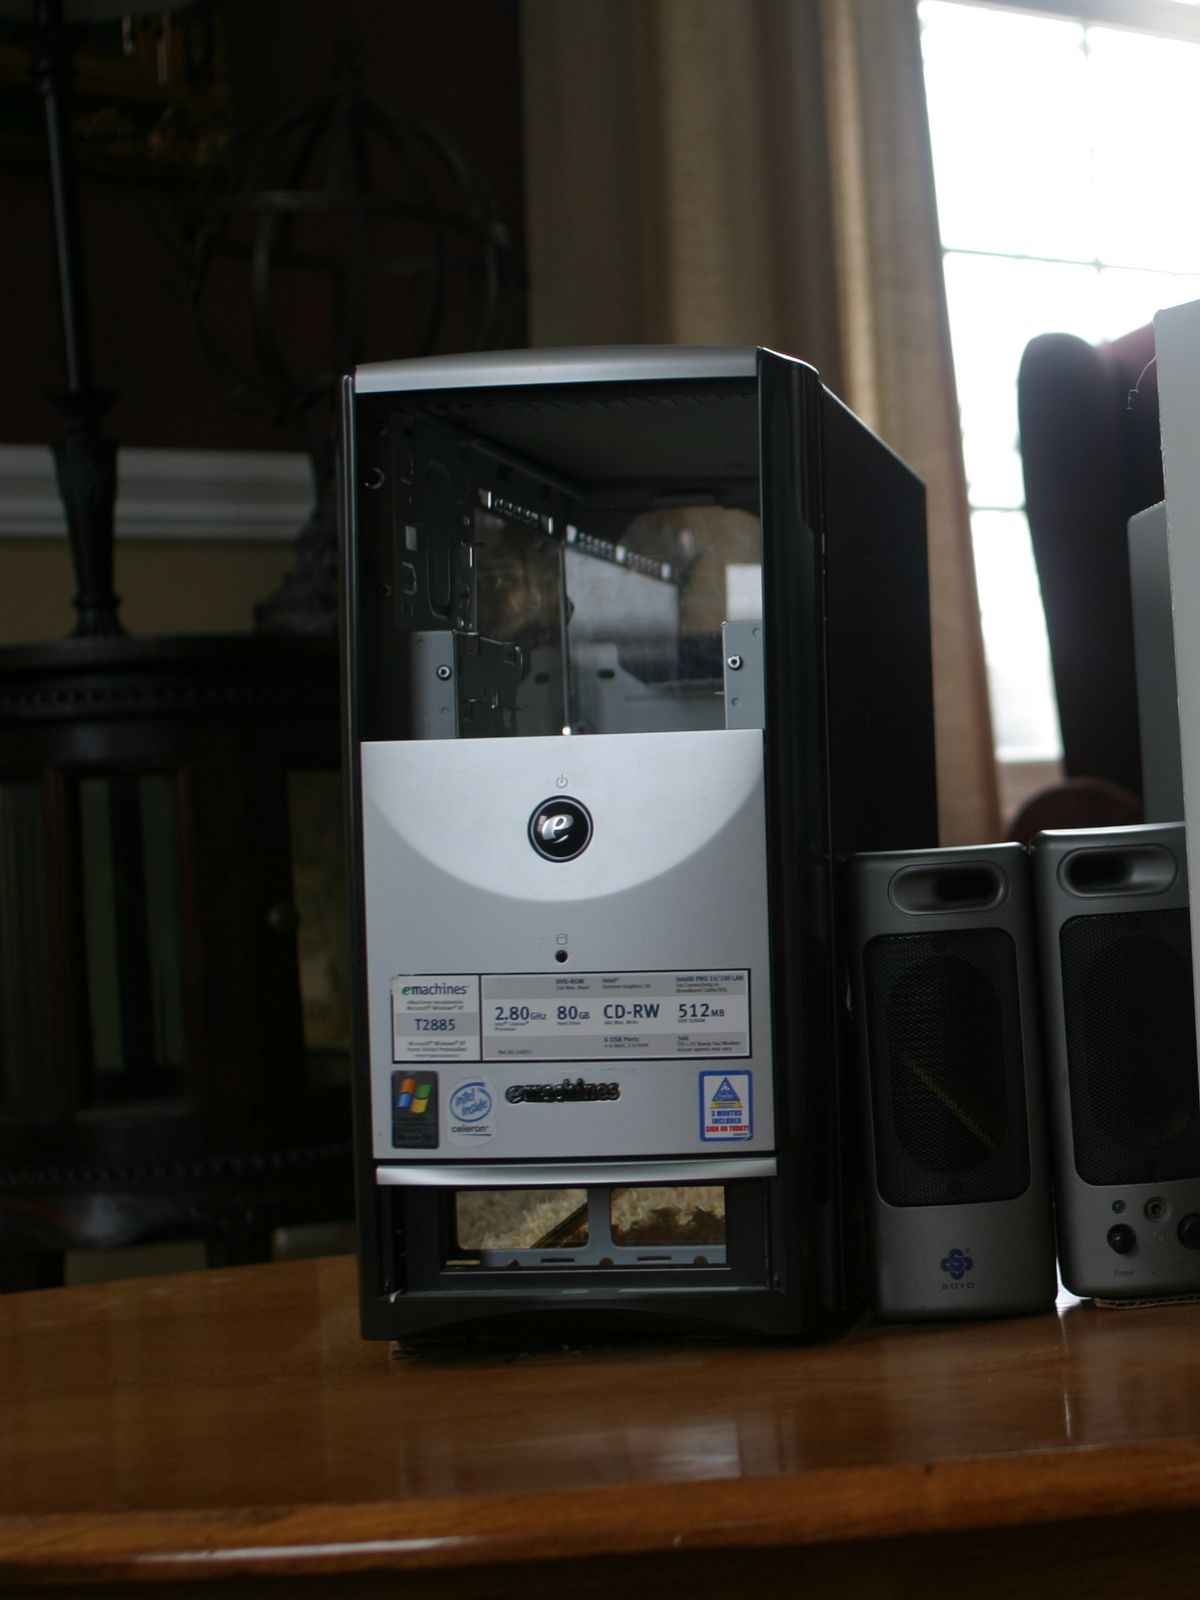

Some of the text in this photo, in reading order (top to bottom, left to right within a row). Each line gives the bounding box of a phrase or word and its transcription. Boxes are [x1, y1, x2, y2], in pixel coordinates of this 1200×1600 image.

[603, 1003, 660, 1019] CD-RW
[678, 1003, 725, 1018] 512MB
[414, 1018, 456, 1031] T2885
[941, 1281, 975, 1290] SOYO
